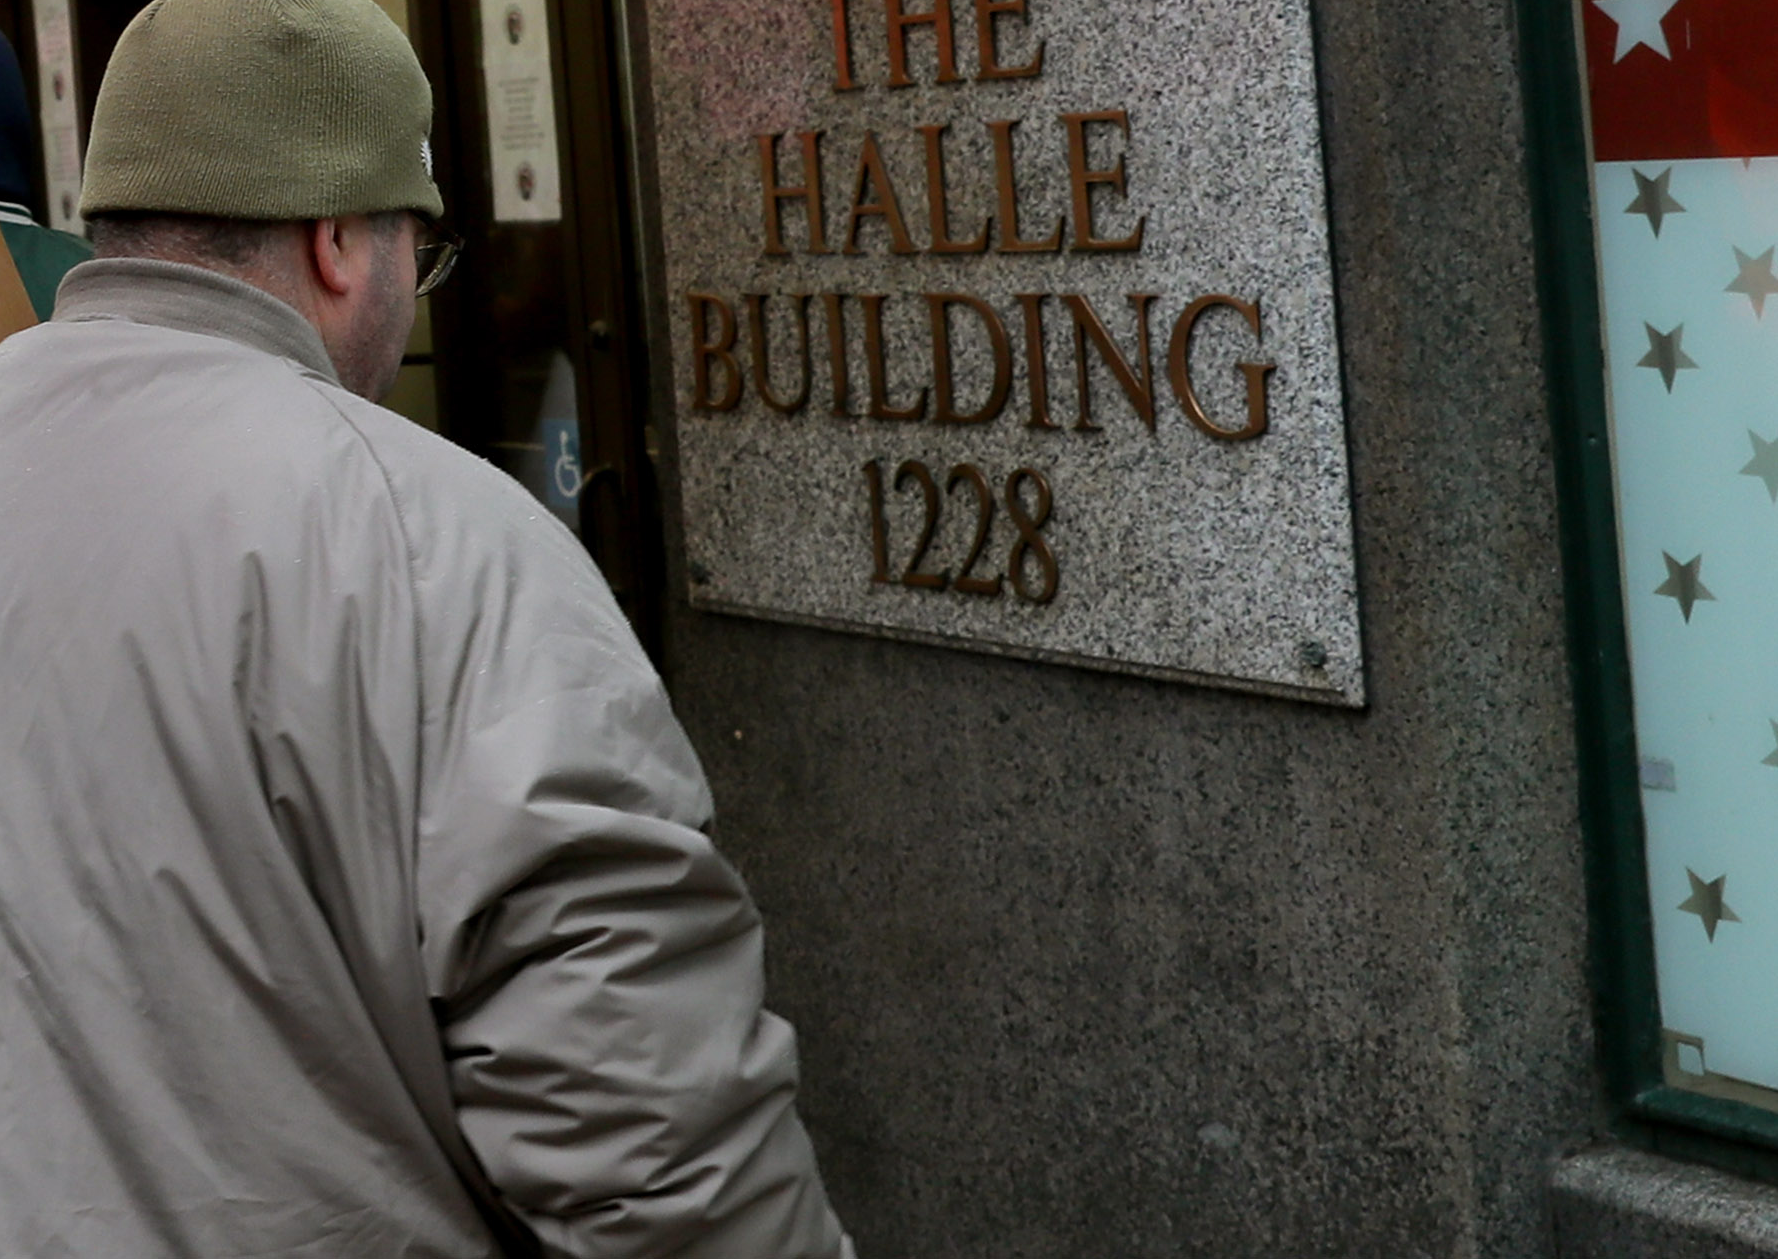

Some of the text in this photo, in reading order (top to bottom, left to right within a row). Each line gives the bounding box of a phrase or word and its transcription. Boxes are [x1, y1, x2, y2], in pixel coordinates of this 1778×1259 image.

[757, 108, 1146, 259] HALLE
[687, 293, 1277, 444] BUILDING
[862, 459, 1060, 605] 1228
